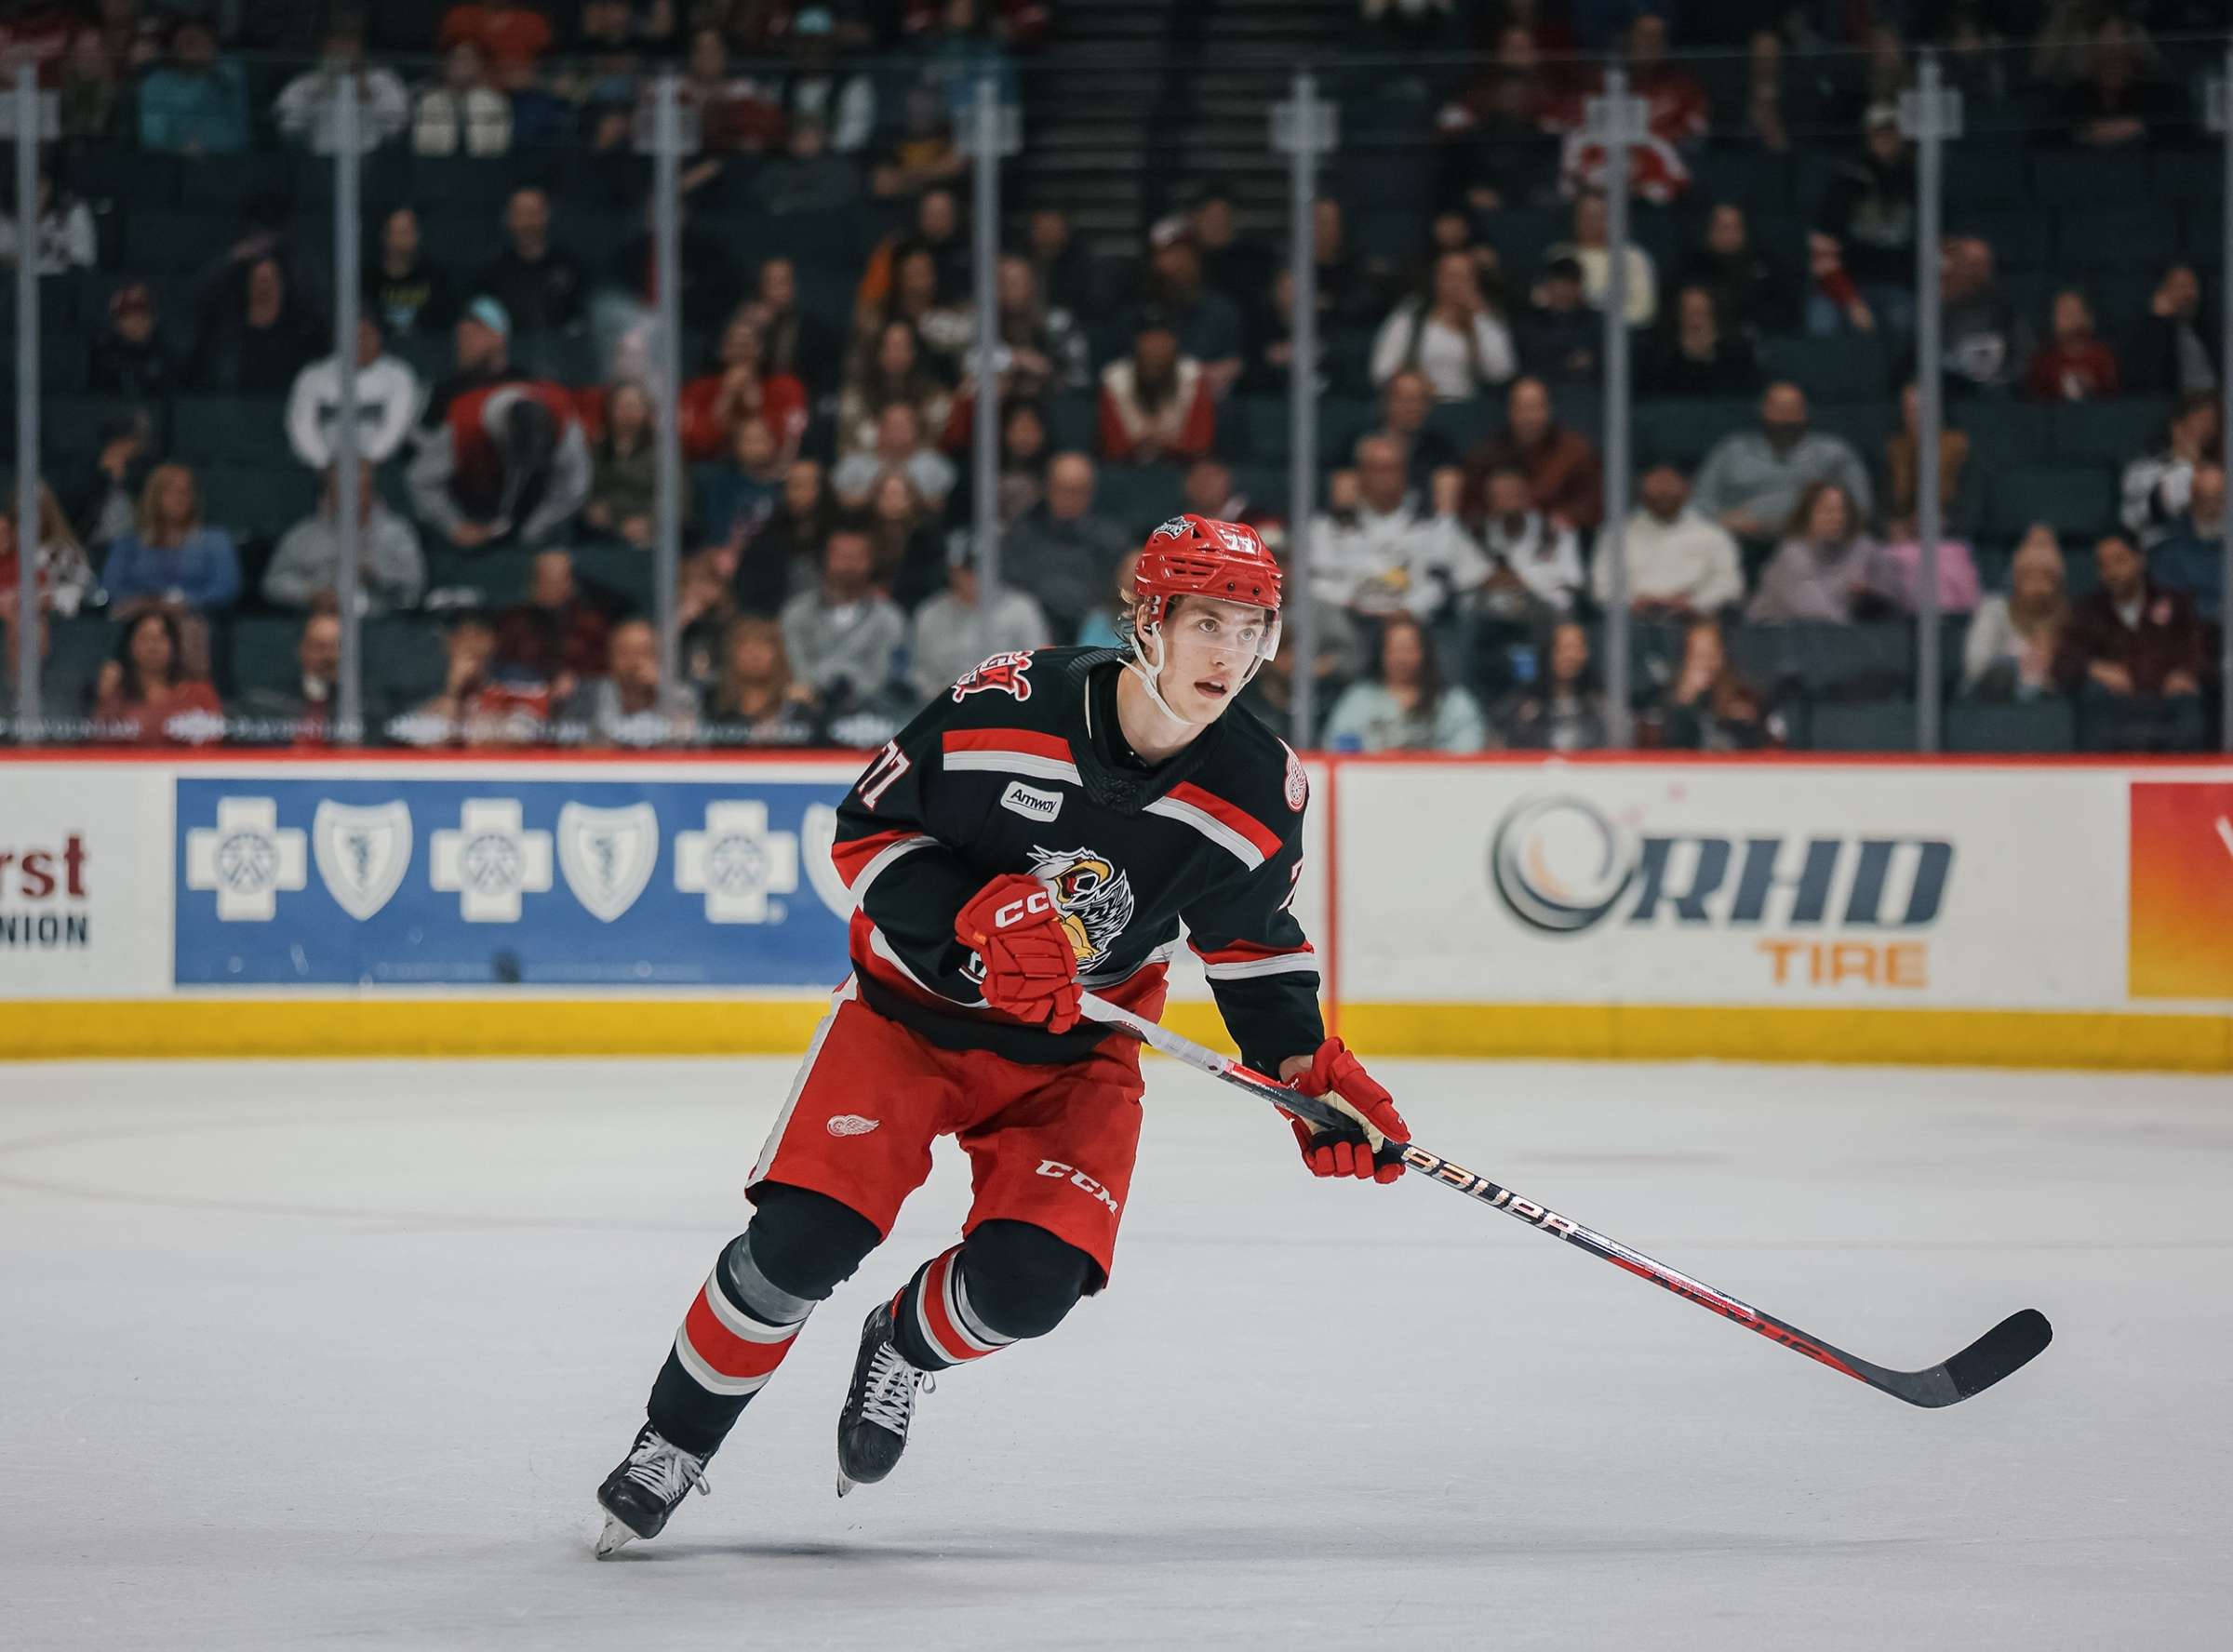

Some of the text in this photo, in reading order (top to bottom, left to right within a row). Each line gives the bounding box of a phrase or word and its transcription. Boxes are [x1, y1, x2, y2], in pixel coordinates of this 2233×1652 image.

[1010, 788, 1058, 814] Amway
[995, 891, 1050, 928] CC
[1758, 939, 1929, 987] TIRE
[1036, 1159, 1118, 1217] CCM
